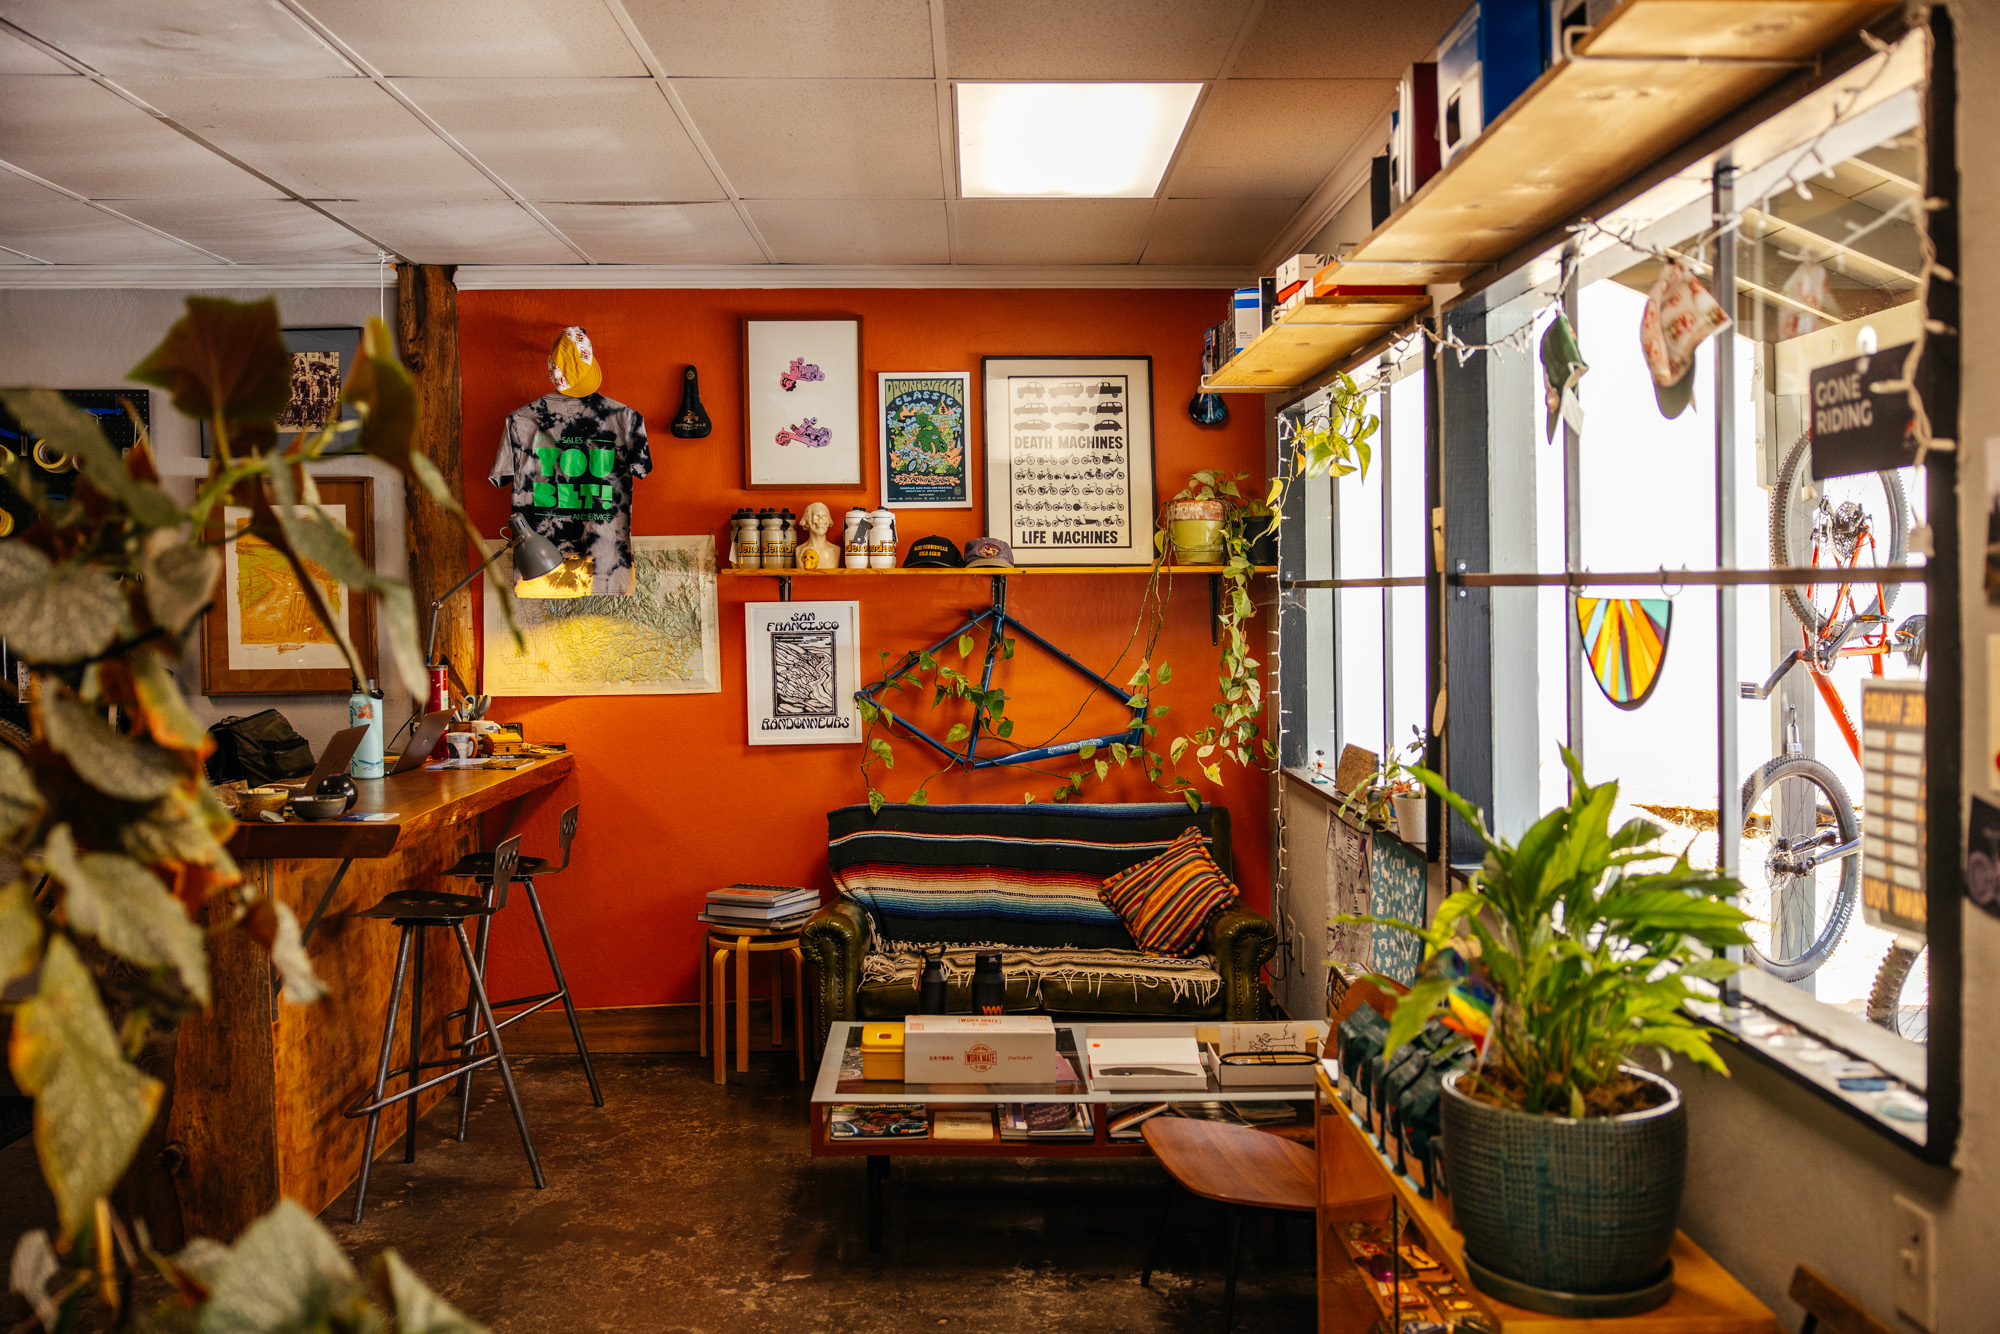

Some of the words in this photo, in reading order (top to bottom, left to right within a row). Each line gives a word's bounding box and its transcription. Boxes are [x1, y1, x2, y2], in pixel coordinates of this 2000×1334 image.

[886, 380, 963, 407] DOWNIEVILLE
[895, 391, 954, 406] CLASSIC
[1815, 374, 1862, 408] GONE
[1816, 399, 1874, 435] RIDING
[562, 436, 584, 444] SALES
[1014, 435, 1053, 450] DEATH
[1058, 435, 1124, 450] MACHINES
[534, 447, 616, 478] YOU
[532, 481, 613, 510] BET!
[1022, 530, 1047, 545] LIFE
[1052, 530, 1119, 545] MACHINES
[791, 612, 817, 621] SAN
[767, 621, 840, 632] FRANCISCO
[761, 717, 850, 731] RANDONNEURS
[966, 1053, 981, 1064] WORK
[981, 1053, 996, 1064] MATE
